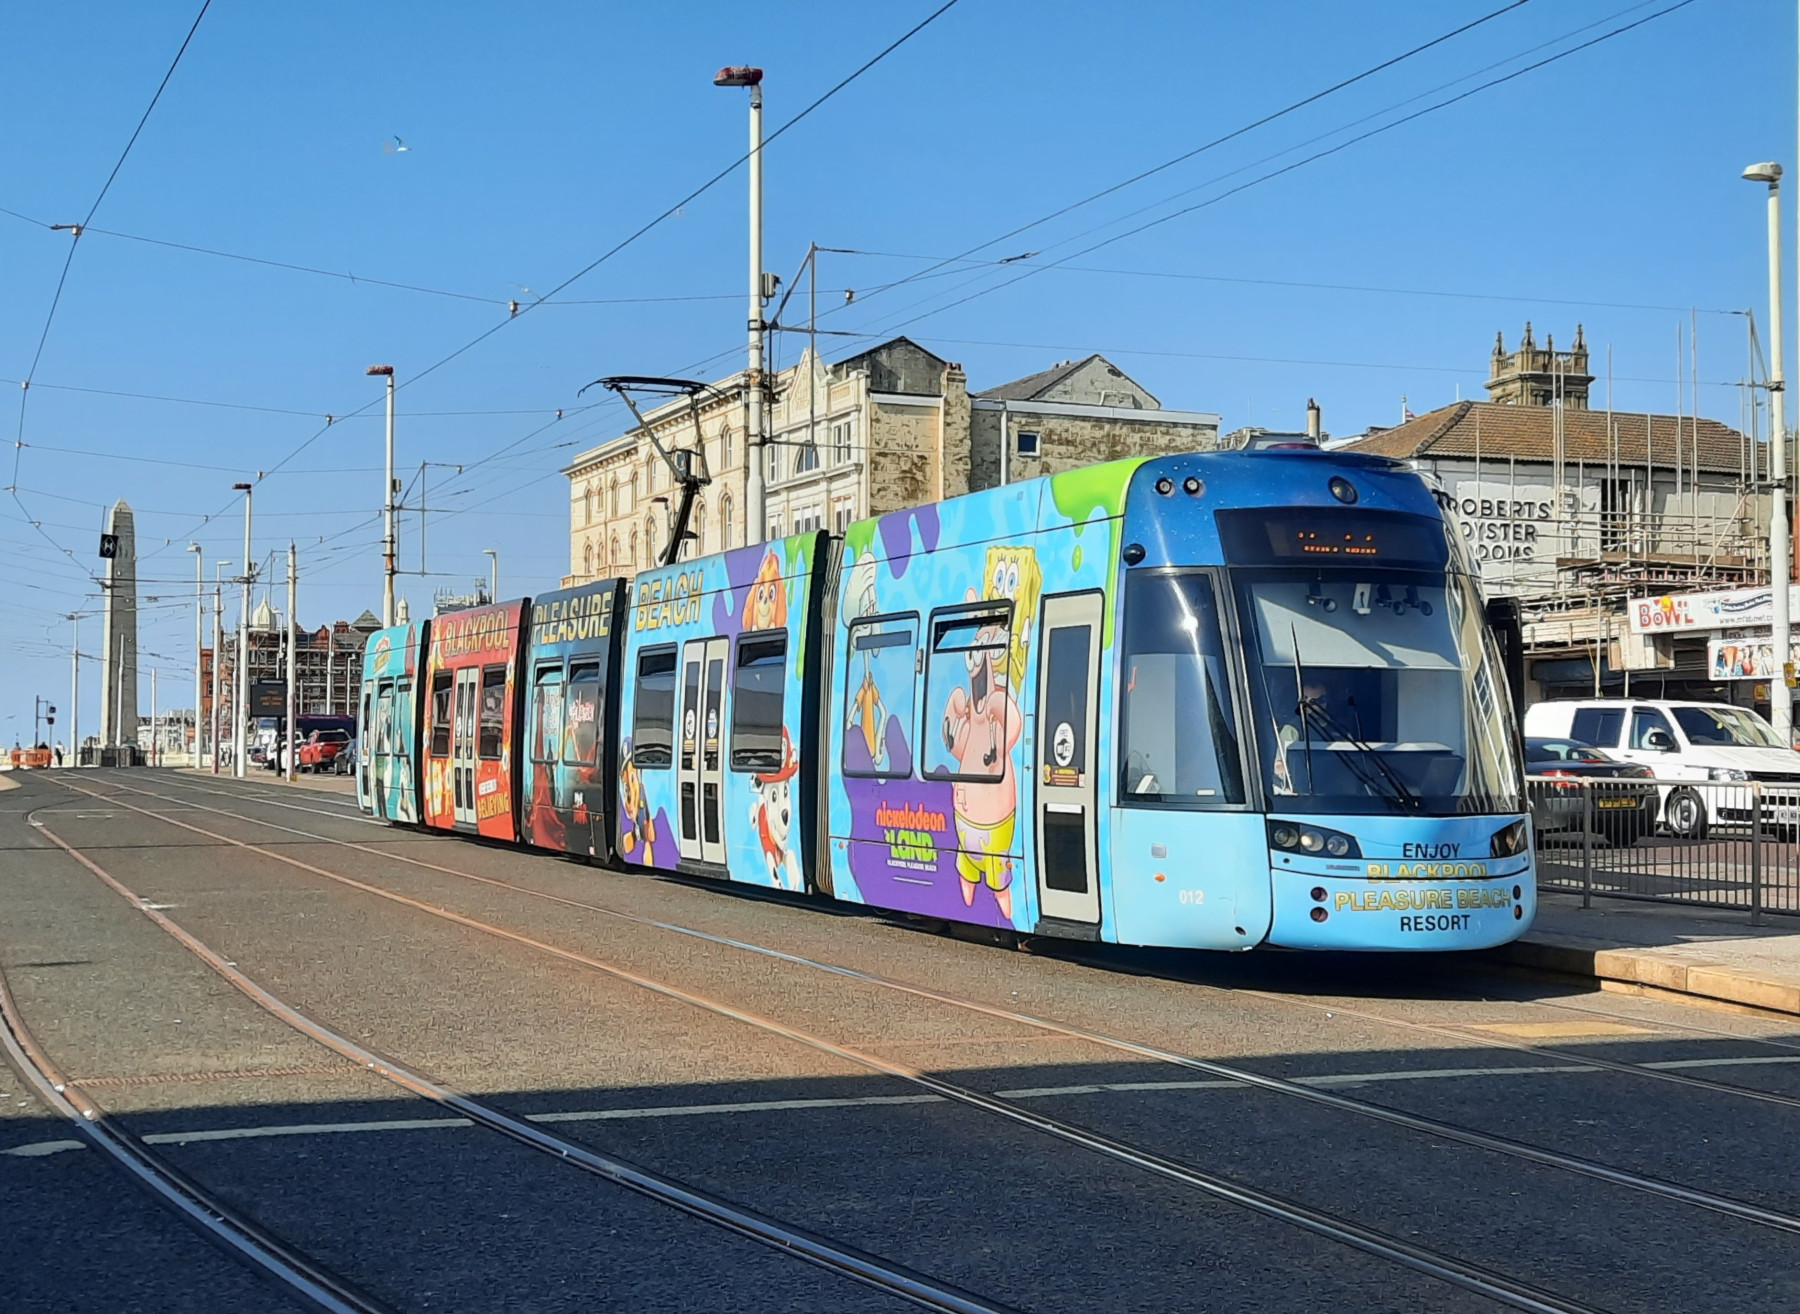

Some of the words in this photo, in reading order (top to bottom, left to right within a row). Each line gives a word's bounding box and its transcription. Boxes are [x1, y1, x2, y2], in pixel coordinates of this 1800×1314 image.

[1460, 521, 1536, 541] OYSTER
[1476, 544, 1534, 561] OOMS
[444, 609, 511, 658] BLACKPOOL
[532, 590, 613, 645] PLEASURE
[636, 570, 704, 631] BEACH
[876, 800, 947, 832] nickelodeon
[1403, 843, 1460, 858] ENJOY
[1367, 862, 1492, 884] BLACKPOOL
[1178, 889, 1204, 905] 012
[1335, 889, 1453, 911] PLEASURE
[1457, 887, 1511, 909] BEACH
[1400, 914, 1470, 932] RESORT
